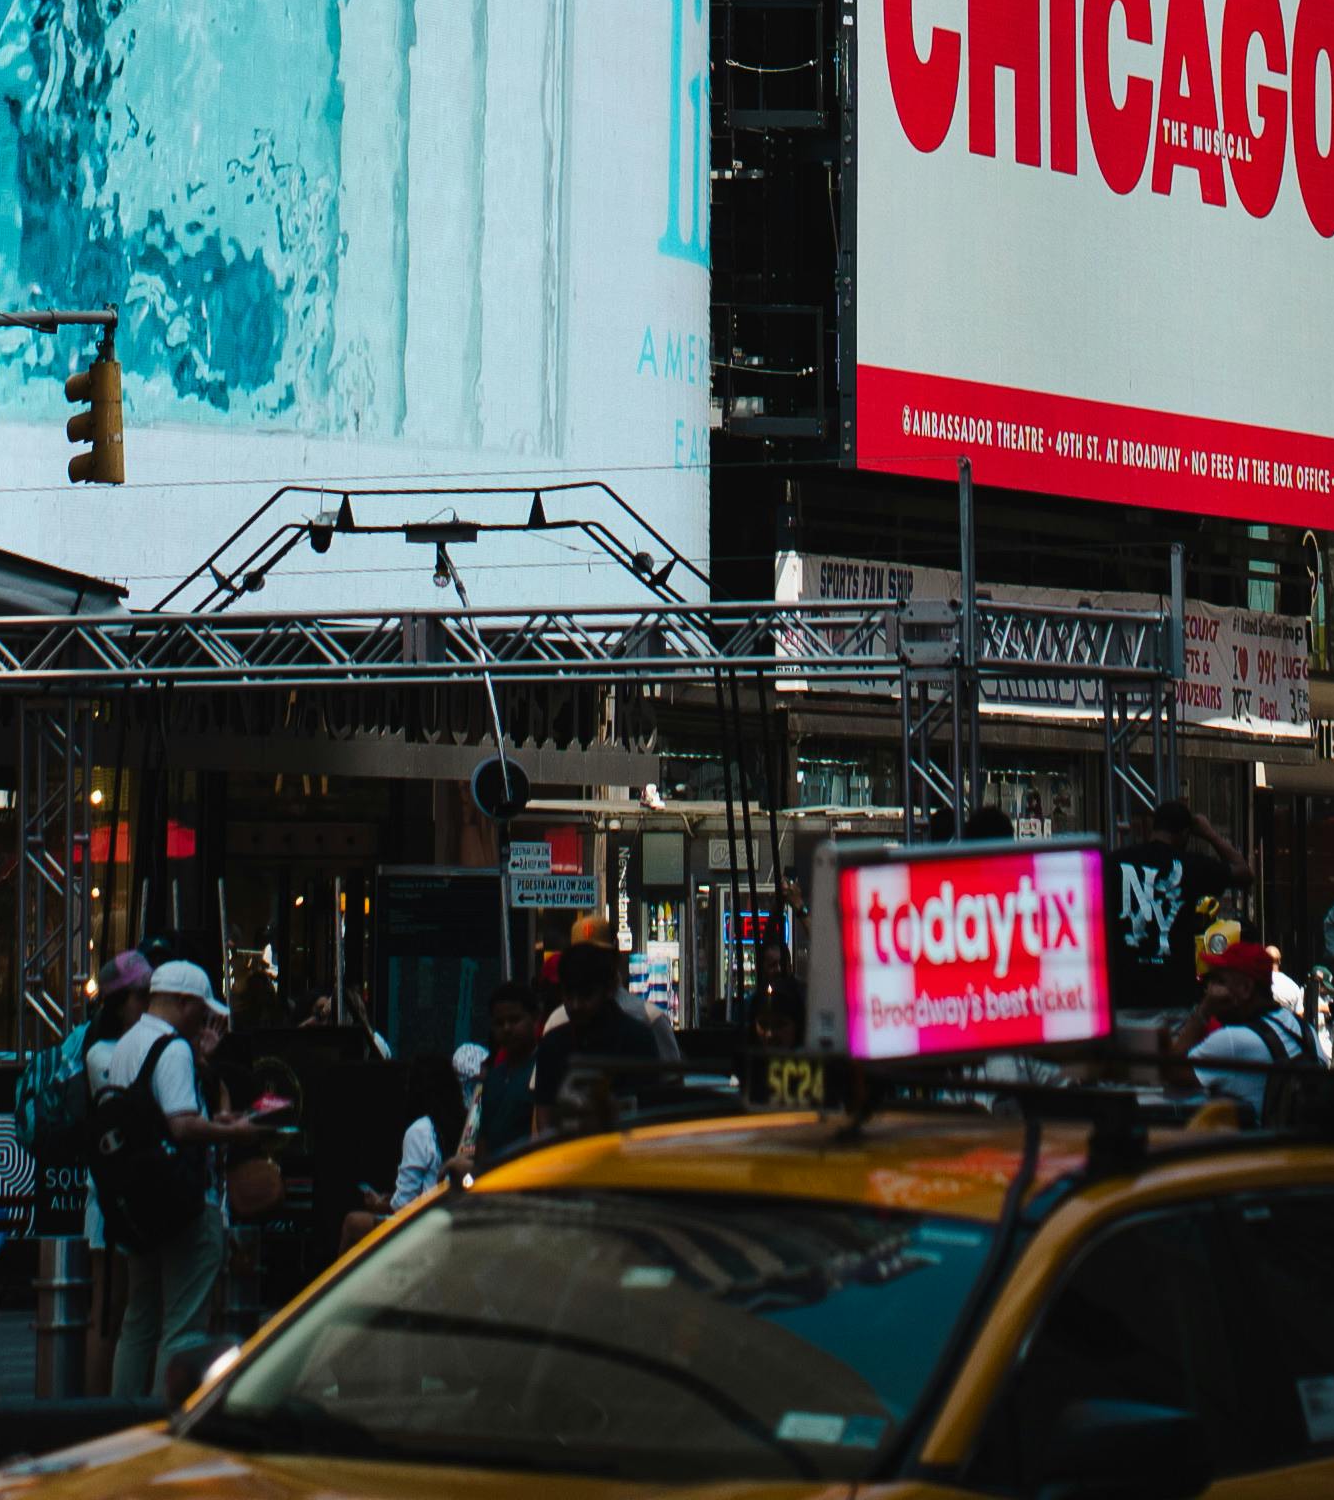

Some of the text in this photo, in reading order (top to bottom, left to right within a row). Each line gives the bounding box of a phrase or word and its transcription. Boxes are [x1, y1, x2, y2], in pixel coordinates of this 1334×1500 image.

[1162, 117, 1252, 163] THE MUSICAL
[912, 408, 1331, 494] AMBASSADOR THEATRE 49TH ST. AT BROADWAY NO FEES AT THE BOX OFFICE
[820, 561, 914, 600] SPORTS FAN SHOP
[517, 877, 595, 891] PEDESTRIAN FLOW ZONE
[569, 893, 595, 904] MOVING
[869, 874, 1078, 979] todaytix
